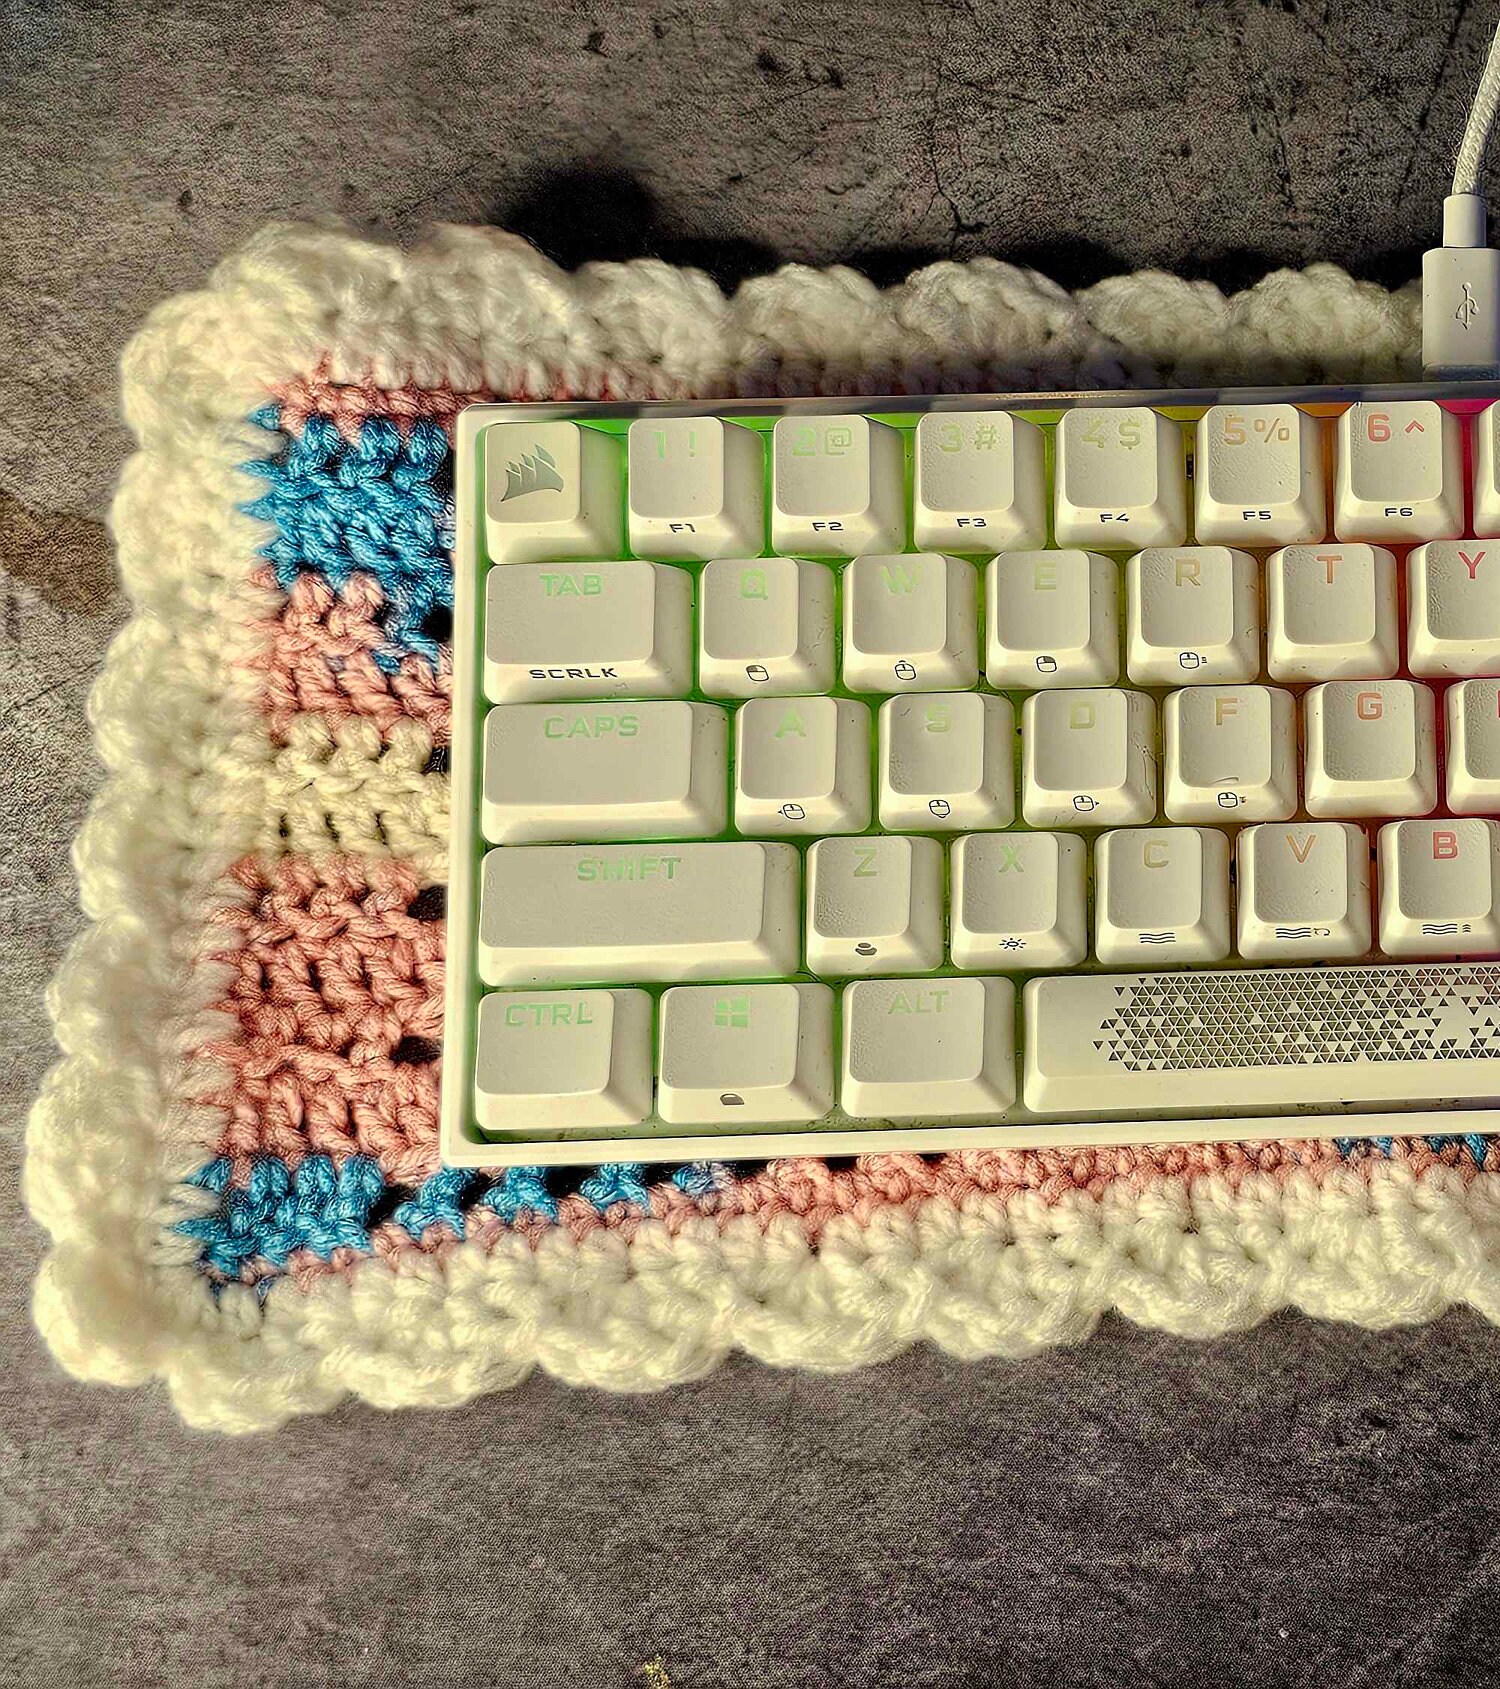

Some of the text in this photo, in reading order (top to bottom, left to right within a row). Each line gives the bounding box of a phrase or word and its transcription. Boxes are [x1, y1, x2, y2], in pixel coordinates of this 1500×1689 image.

[957, 518, 987, 528] F3
[1100, 514, 1129, 523] F4
[1242, 510, 1272, 520] F5
[1384, 507, 1413, 517] F6
[670, 523, 696, 533] F1
[813, 522, 843, 532] F2
[1035, 563, 1056, 590] E
[1175, 559, 1200, 586] R
[1317, 556, 1342, 583] T
[1458, 552, 1485, 579] Y
[540, 575, 602, 597] TAB
[741, 570, 768, 599] Q
[880, 566, 921, 593] W
[529, 668, 618, 679] SCRLK
[926, 706, 952, 733] S
[1070, 704, 1095, 729] D
[1215, 698, 1238, 725] F
[1357, 693, 1383, 720] G
[544, 715, 639, 739] CAPS
[774, 711, 806, 738] A
[1143, 840, 1168, 868] C
[1286, 835, 1316, 863] V
[1433, 831, 1458, 859] B
[577, 858, 681, 881] SHIFT
[854, 848, 877, 876] Z
[999, 846, 1024, 872] X
[505, 1003, 593, 1026] CTRL
[888, 991, 949, 1014] ALT
